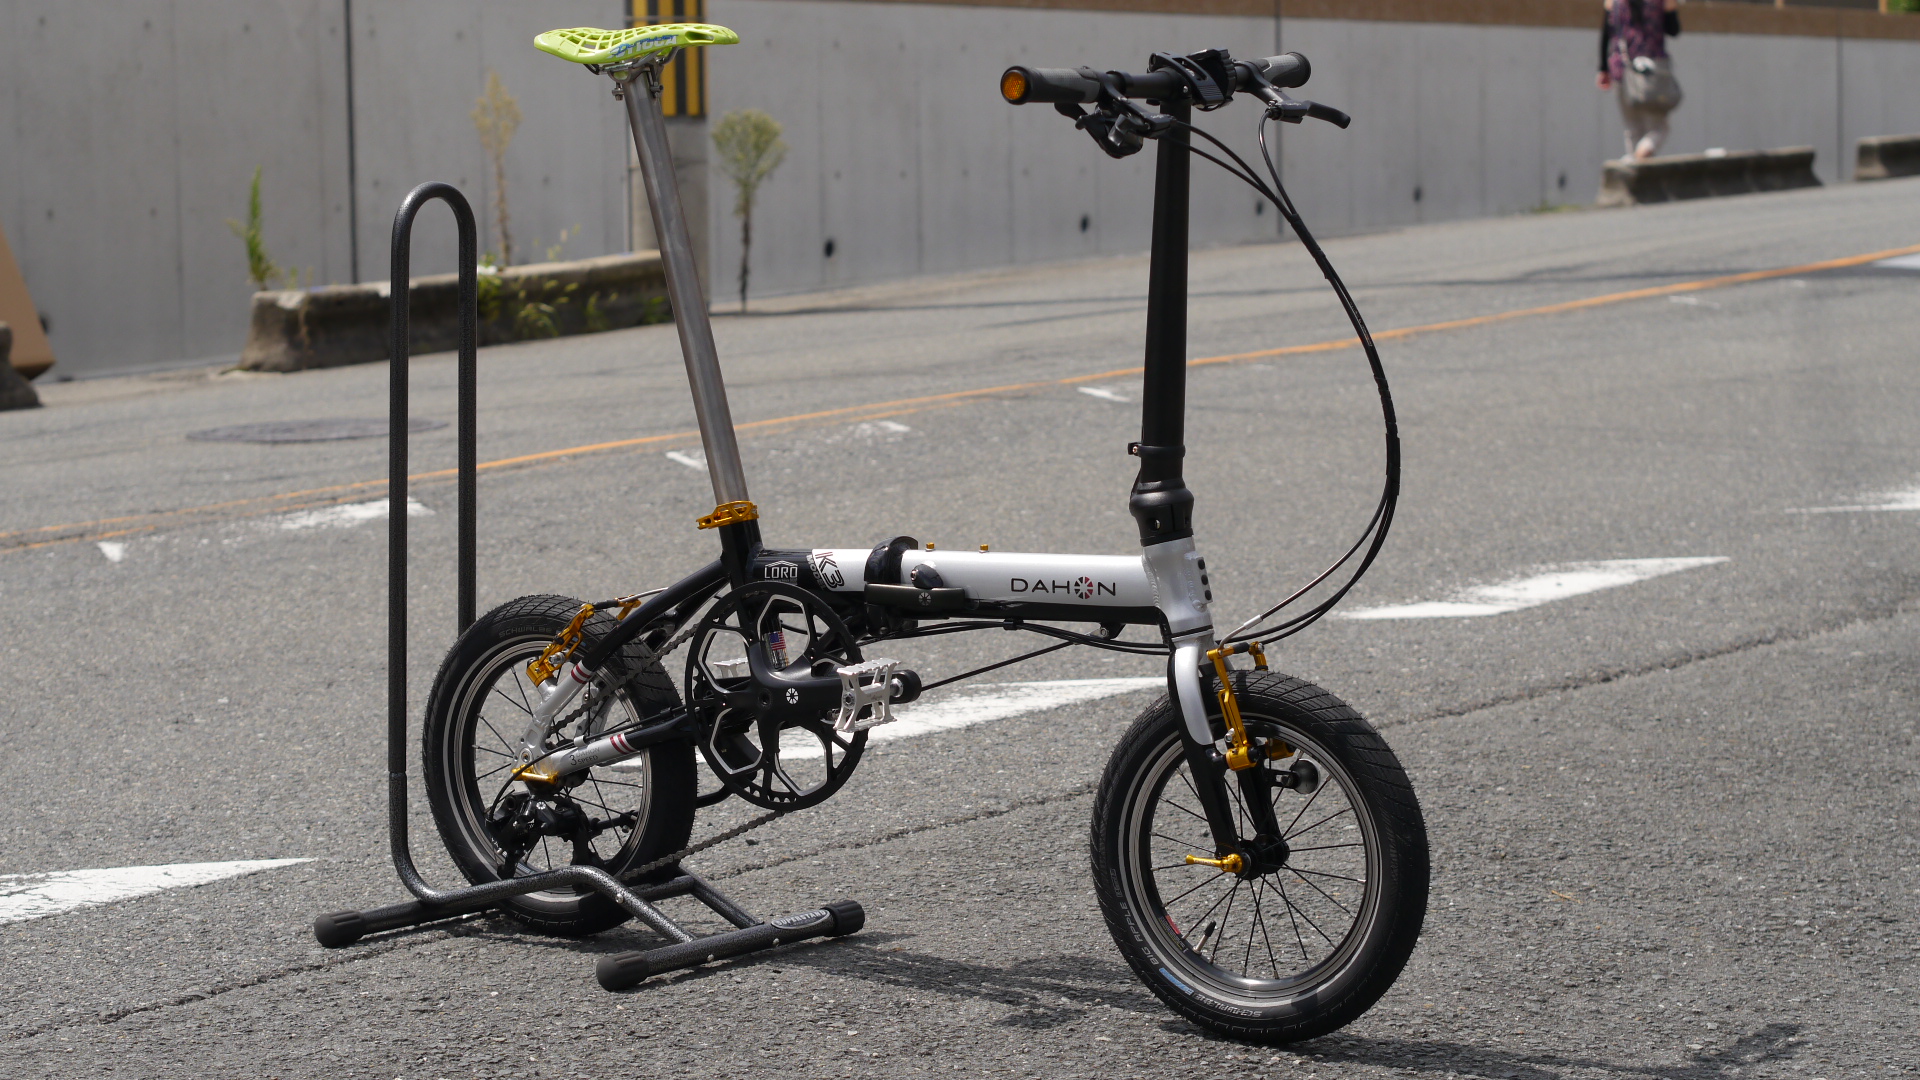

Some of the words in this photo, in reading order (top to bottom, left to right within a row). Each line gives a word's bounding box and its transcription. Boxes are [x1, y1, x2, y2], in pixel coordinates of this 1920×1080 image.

[764, 566, 798, 579] LORO
[806, 554, 827, 590] MODEL
[815, 552, 845, 588] K3
[1010, 576, 1116, 600] DAHON
[499, 626, 552, 638] SCHWALBE
[569, 754, 578, 766] 3
[577, 755, 599, 764] SPEED
[775, 910, 826, 926] SUPERSTAND
[1119, 901, 1143, 942] APPLE
[1141, 947, 1160, 965] BIG
